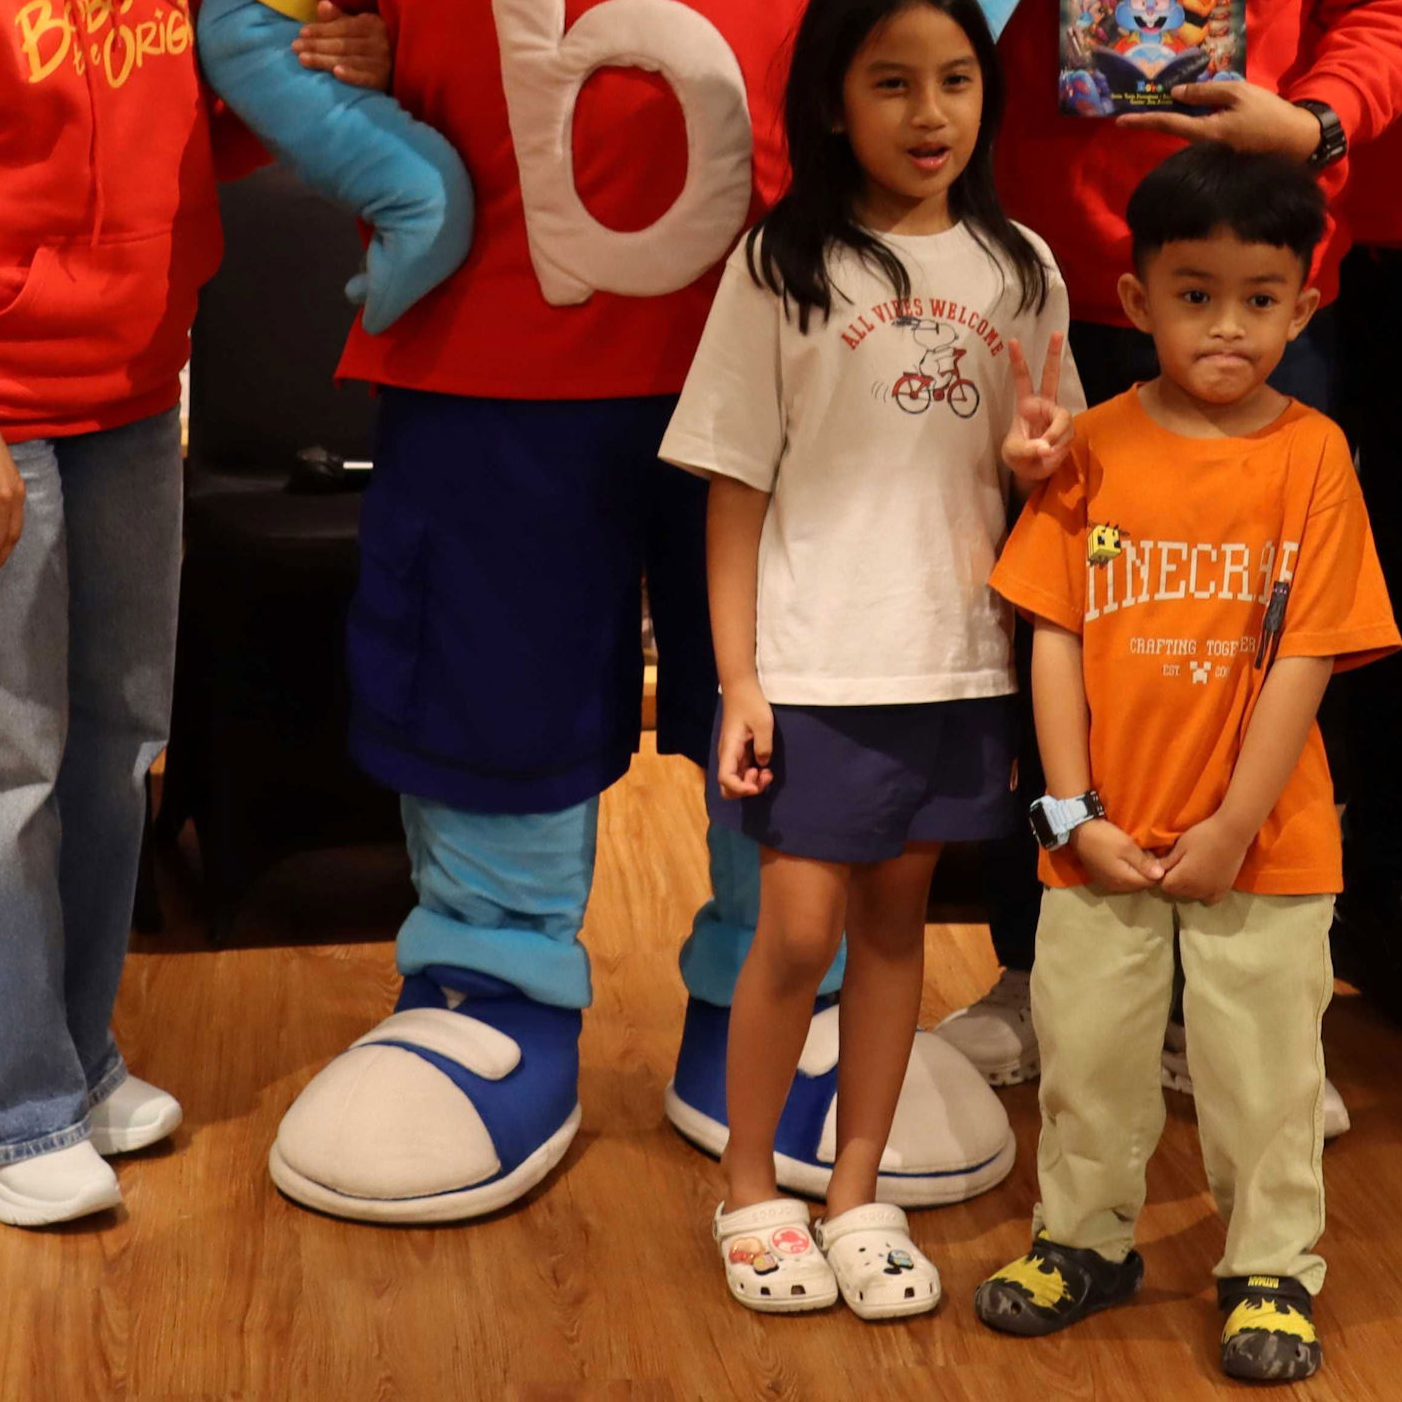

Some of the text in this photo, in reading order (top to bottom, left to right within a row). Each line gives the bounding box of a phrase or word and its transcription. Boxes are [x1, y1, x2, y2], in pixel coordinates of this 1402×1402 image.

[840, 297, 1006, 357] ALL VIBES WELCOME
[1129, 637, 1197, 656] CRAFTING
